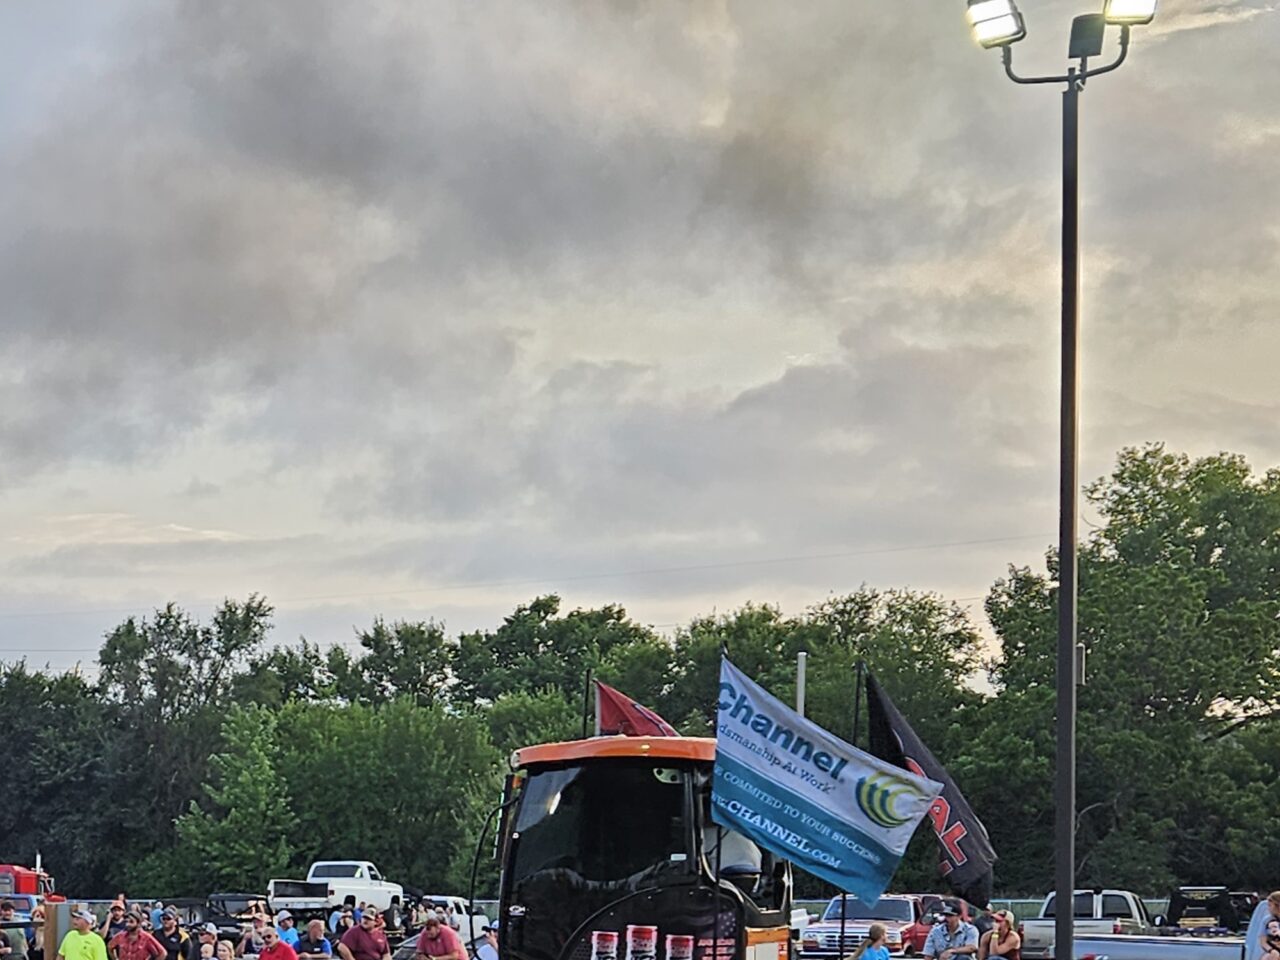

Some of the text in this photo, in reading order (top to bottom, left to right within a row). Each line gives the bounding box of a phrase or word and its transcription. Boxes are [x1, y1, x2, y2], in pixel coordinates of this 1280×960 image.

[718, 681, 850, 780] Channel
[799, 766, 832, 795] Work
[783, 803, 800, 818] TO
[800, 812, 832, 837] YOUR
